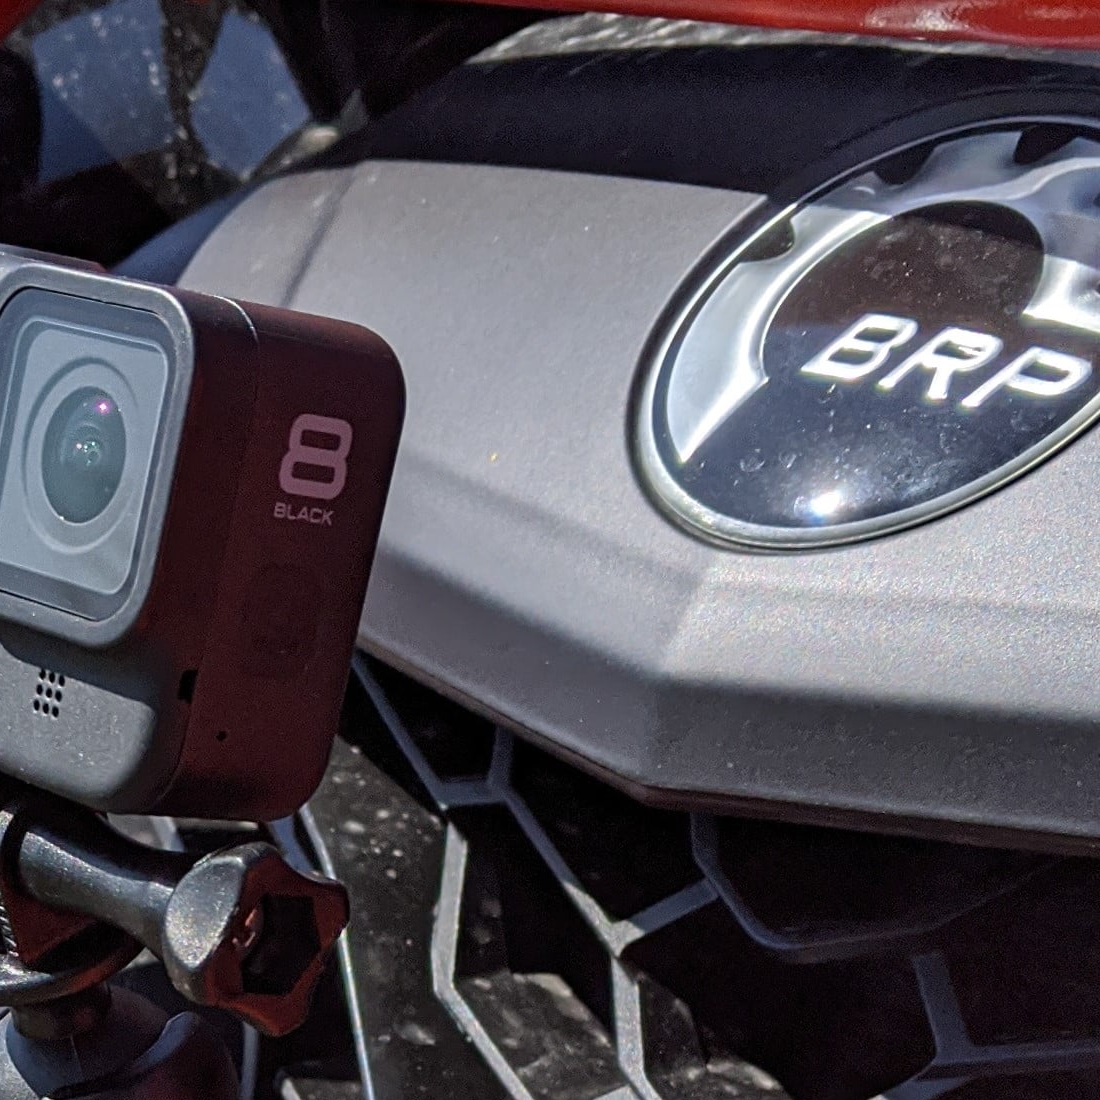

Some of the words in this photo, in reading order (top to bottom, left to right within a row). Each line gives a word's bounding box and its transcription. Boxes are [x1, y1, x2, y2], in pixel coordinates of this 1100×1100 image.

[801, 312, 1093, 408] BRP
[278, 413, 353, 500] 8
[273, 502, 335, 526] BLACK
